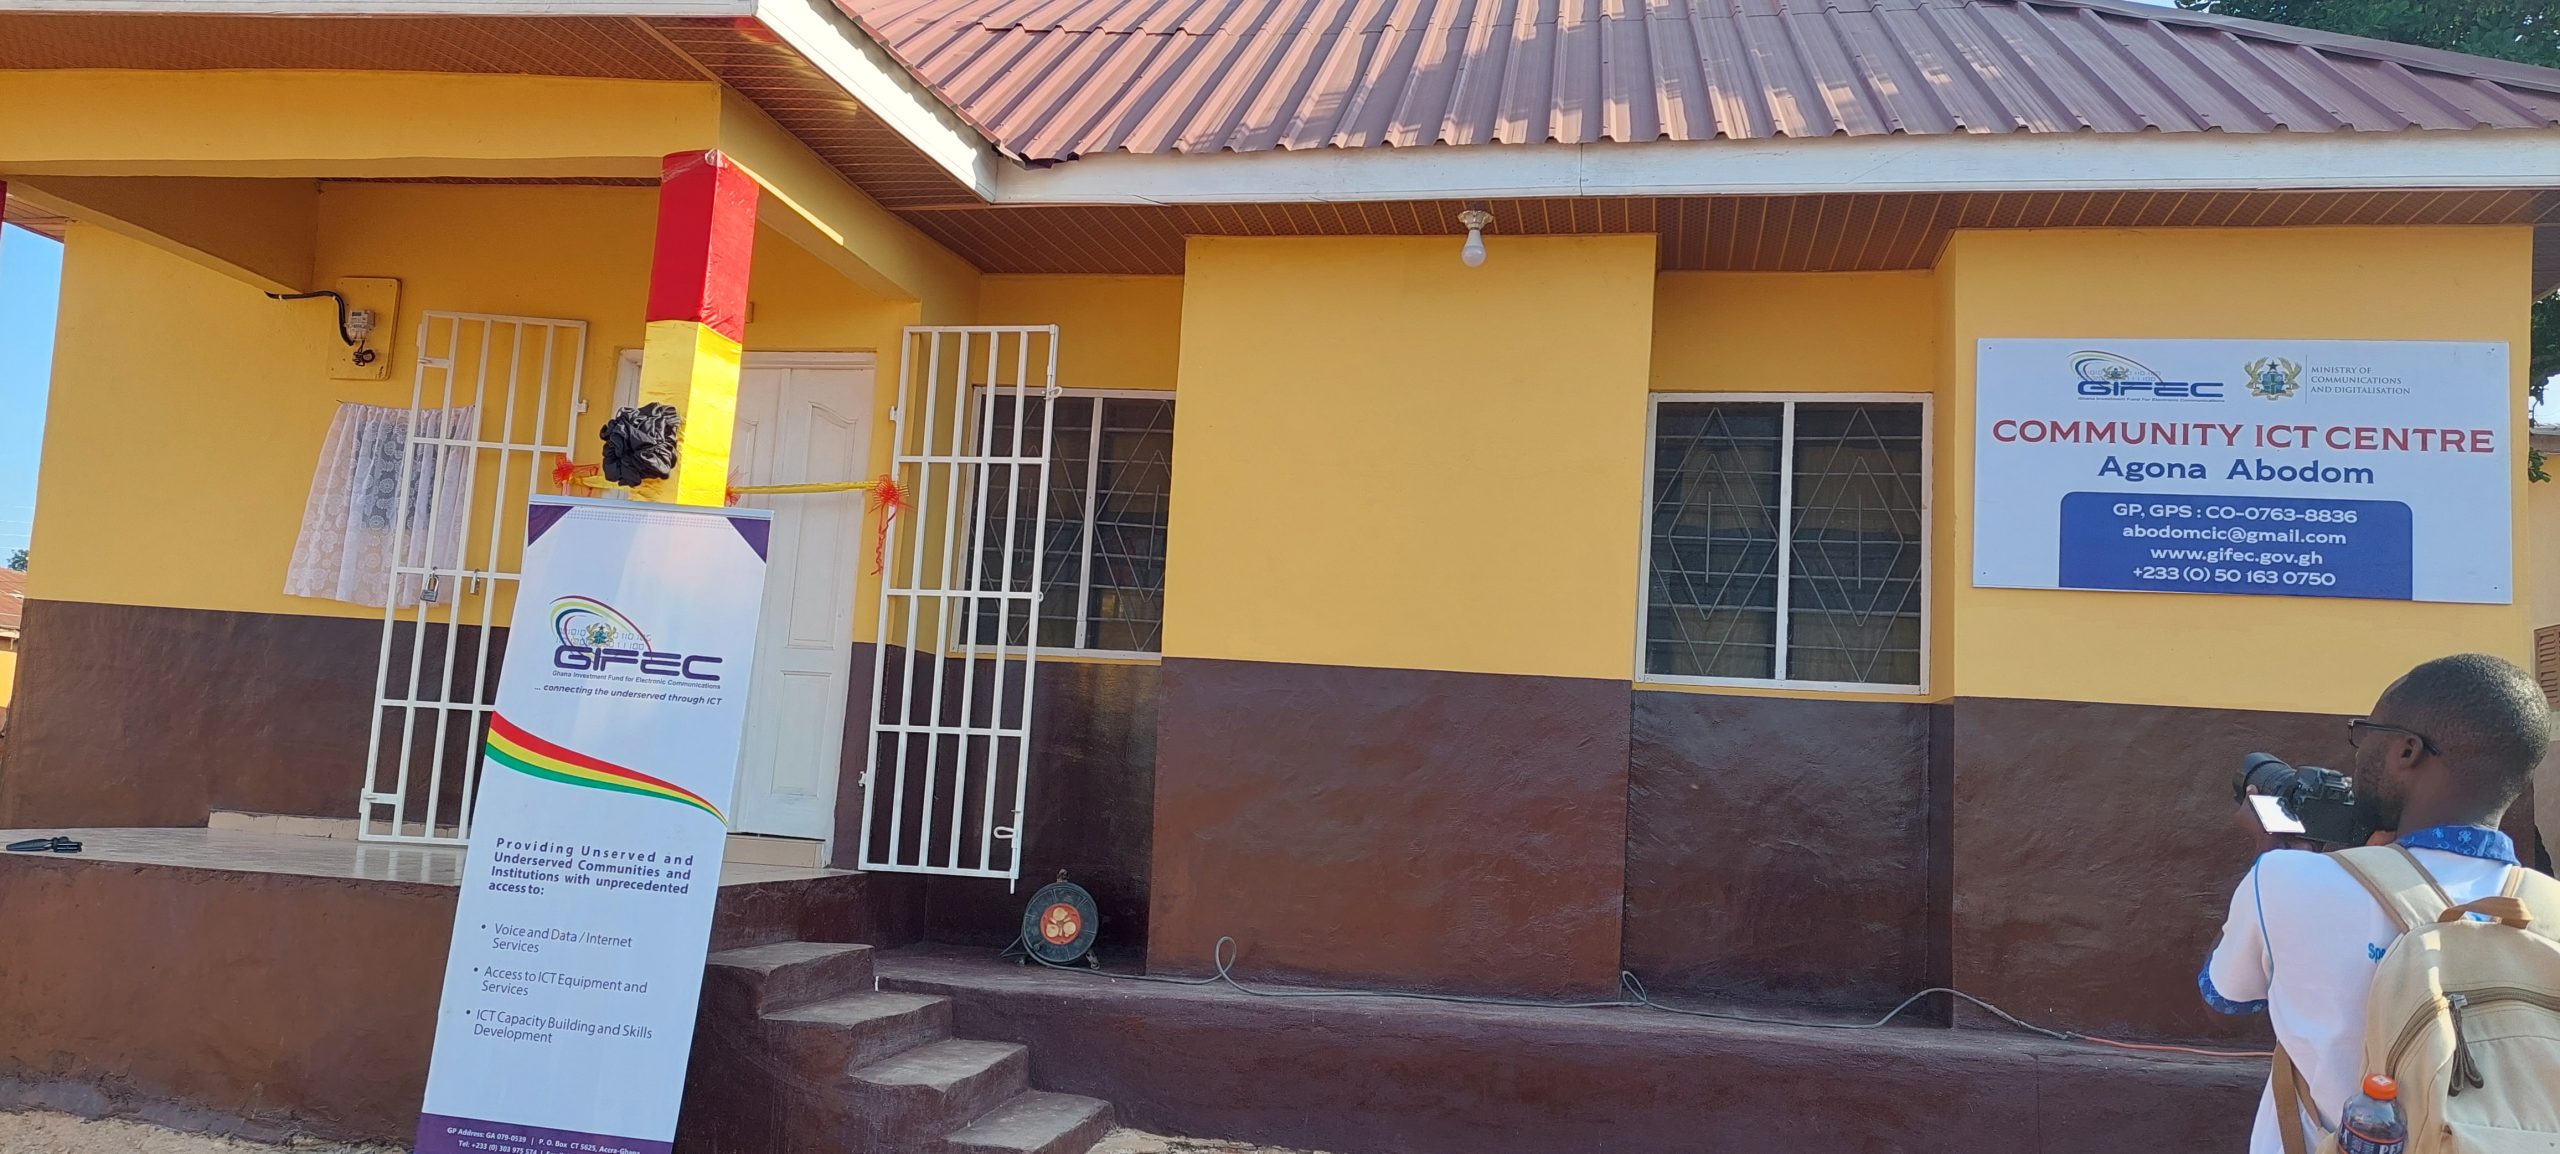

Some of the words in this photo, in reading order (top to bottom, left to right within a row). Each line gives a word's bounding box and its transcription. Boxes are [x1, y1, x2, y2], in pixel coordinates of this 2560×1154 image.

[2310, 376, 2402, 384] COMMUNICATIONS
[2311, 366, 2357, 374] MINISTRY
[2358, 367, 2372, 375] OF
[2077, 380, 2224, 398] GIFEC
[2334, 386, 2411, 395] DIGITALISATION
[1993, 419, 2244, 447] COMMUNITY
[2255, 424, 2318, 449] ICT
[2325, 426, 2496, 453] CENTRE
[2097, 455, 2207, 483] Agona
[2225, 458, 2375, 484] Abodom
[2113, 503, 2146, 519] GP,
[2149, 504, 2193, 518] GPS
[2205, 506, 2358, 524] CO-0763-8836
[2122, 524, 2347, 545] abodomcic@gmail.com
[2150, 548, 2324, 567] www.gifec.gov.gh
[2133, 566, 2180, 580] +233
[2183, 567, 2211, 582] (0)
[2214, 569, 2242, 583] 50
[2246, 570, 2278, 584] 163
[2283, 571, 2336, 586] 0750
[554, 645, 723, 681] GIFEC
[552, 670, 572, 678] Ghana
[573, 671, 607, 680] Investment
[635, 676, 666, 685] Electronic
[667, 679, 721, 690] Communications
[543, 684, 593, 696] connecting
[594, 688, 609, 696] the
[610, 689, 667, 701] underserved
[668, 693, 705, 705] through
[706, 697, 722, 706] ICT
[496, 837, 574, 858] Providing
[581, 845, 657, 863] Unserved
[663, 855, 694, 866] and
[494, 851, 573, 869] Underserved
[577, 859, 660, 877] Communities
[666, 869, 692, 881] and
[488, 882, 527, 894] access
[528, 884, 545, 896] to:
[491, 865, 560, 882] Institutions
[564, 873, 590, 885] with
[595, 878, 689, 895] unprecedented
[492, 937, 540, 953] Services
[495, 922, 526, 937] Voice
[526, 928, 550, 940] and
[550, 928, 577, 942] Data
[586, 932, 633, 948] Internet
[481, 980, 529, 996] Services
[484, 965, 523, 981] Access
[524, 971, 537, 982] to
[537, 971, 557, 984] ICT
[557, 973, 622, 991] Equipment
[623, 981, 648, 994] and
[473, 1023, 552, 1044] Development
[476, 1009, 496, 1022] ICT
[497, 1011, 546, 1030] Capacity
[547, 1016, 596, 1036] Building
[596, 1023, 621, 1036] and
[622, 1024, 653, 1040] Skills
[485, 1131, 496, 1140] GA
[554, 1140, 568, 1148] Box
[570, 1142, 580, 1150] CT
